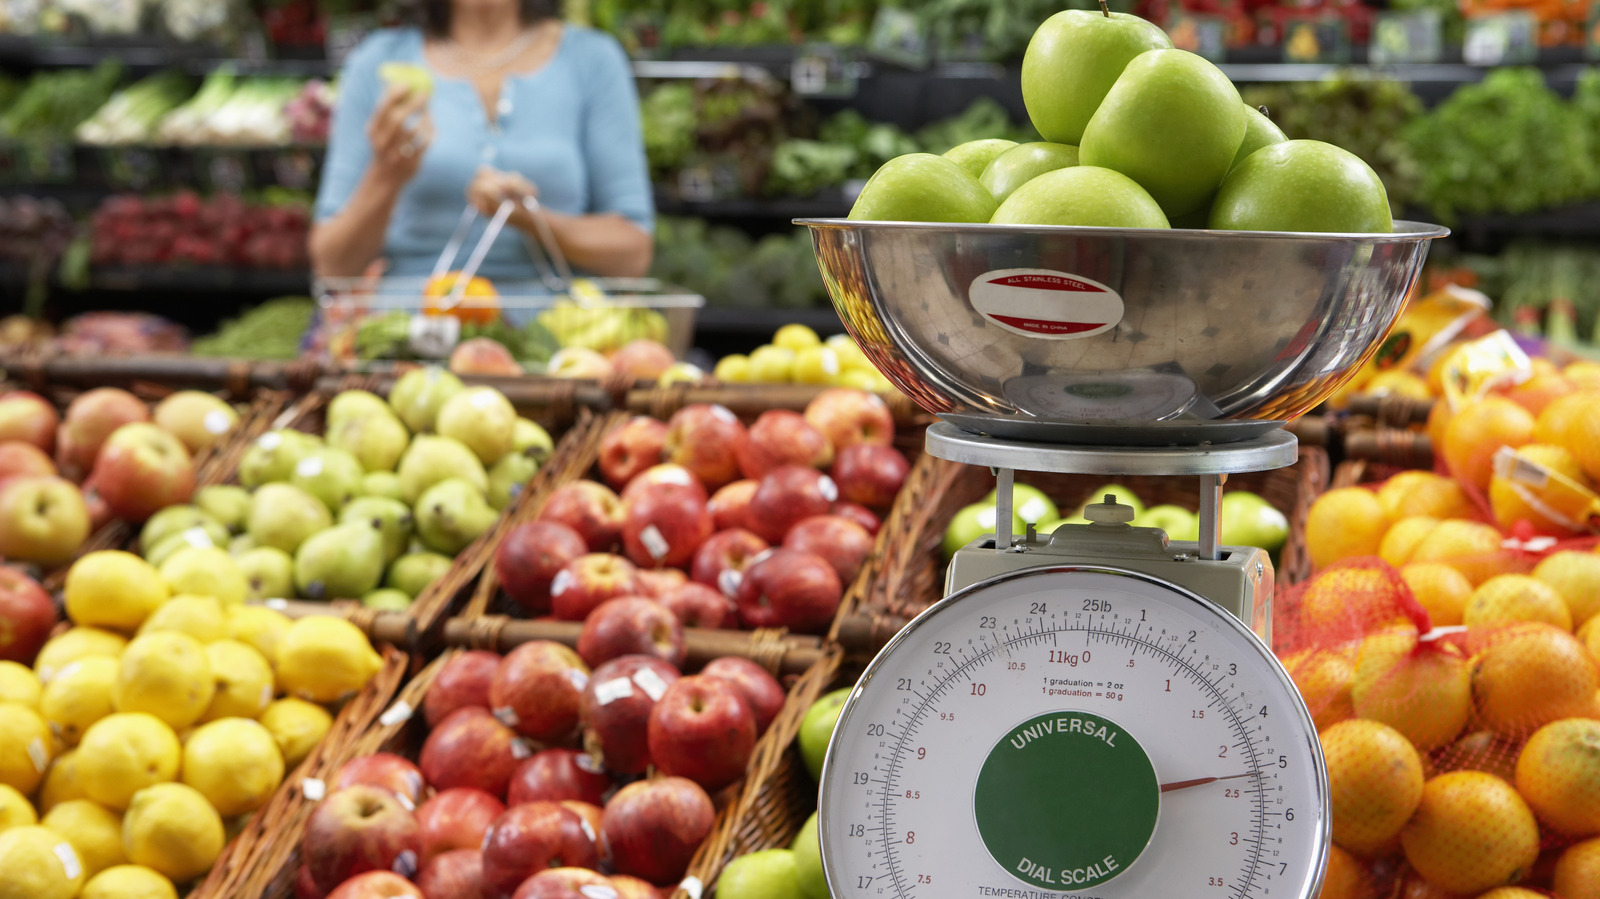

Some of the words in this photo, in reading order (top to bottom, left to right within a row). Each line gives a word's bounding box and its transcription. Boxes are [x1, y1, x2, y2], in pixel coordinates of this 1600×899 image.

[1023, 276, 1062, 285] STAINLESS
[1063, 279, 1086, 290] STEEL
[1030, 602, 1046, 614] 24
[1082, 599, 1112, 612] 25lb
[1140, 609, 1146, 621] 1
[980, 616, 996, 628] 23
[1188, 630, 1196, 642] 2
[934, 642, 952, 654] 22
[1048, 650, 1078, 667] 11kg
[1082, 650, 1091, 663] 0
[1126, 660, 1134, 668] .5
[1008, 662, 1026, 670] 10.5
[1228, 664, 1237, 676] 3
[896, 678, 912, 690] 21
[970, 682, 986, 696] 10
[1050, 678, 1093, 688] graduation
[1165, 680, 1171, 692] 1
[1048, 688, 1092, 698] graduation
[1118, 693, 1123, 701] g
[940, 713, 954, 721] 9.5
[1192, 710, 1204, 718] 1.5
[1259, 706, 1268, 718] 4
[867, 724, 884, 736] 20
[1010, 718, 1117, 750] UNIVERSAL
[917, 747, 926, 760] 9
[1218, 746, 1228, 758] 2
[1278, 756, 1287, 768] 5
[853, 772, 869, 785] 19
[906, 790, 920, 800] 8.5
[1225, 789, 1240, 798] 2.5
[1286, 808, 1294, 821] 6
[849, 824, 865, 837] 18
[906, 831, 915, 844] 8
[1230, 832, 1238, 845] 3
[1016, 857, 1056, 884] DIAL
[1060, 854, 1120, 885] SCALE
[1280, 862, 1287, 876] 7
[857, 876, 873, 889] 17
[918, 874, 932, 884] 7.5
[1208, 877, 1223, 886] 3.5
[978, 886, 1057, 899] TEMPERATURE
